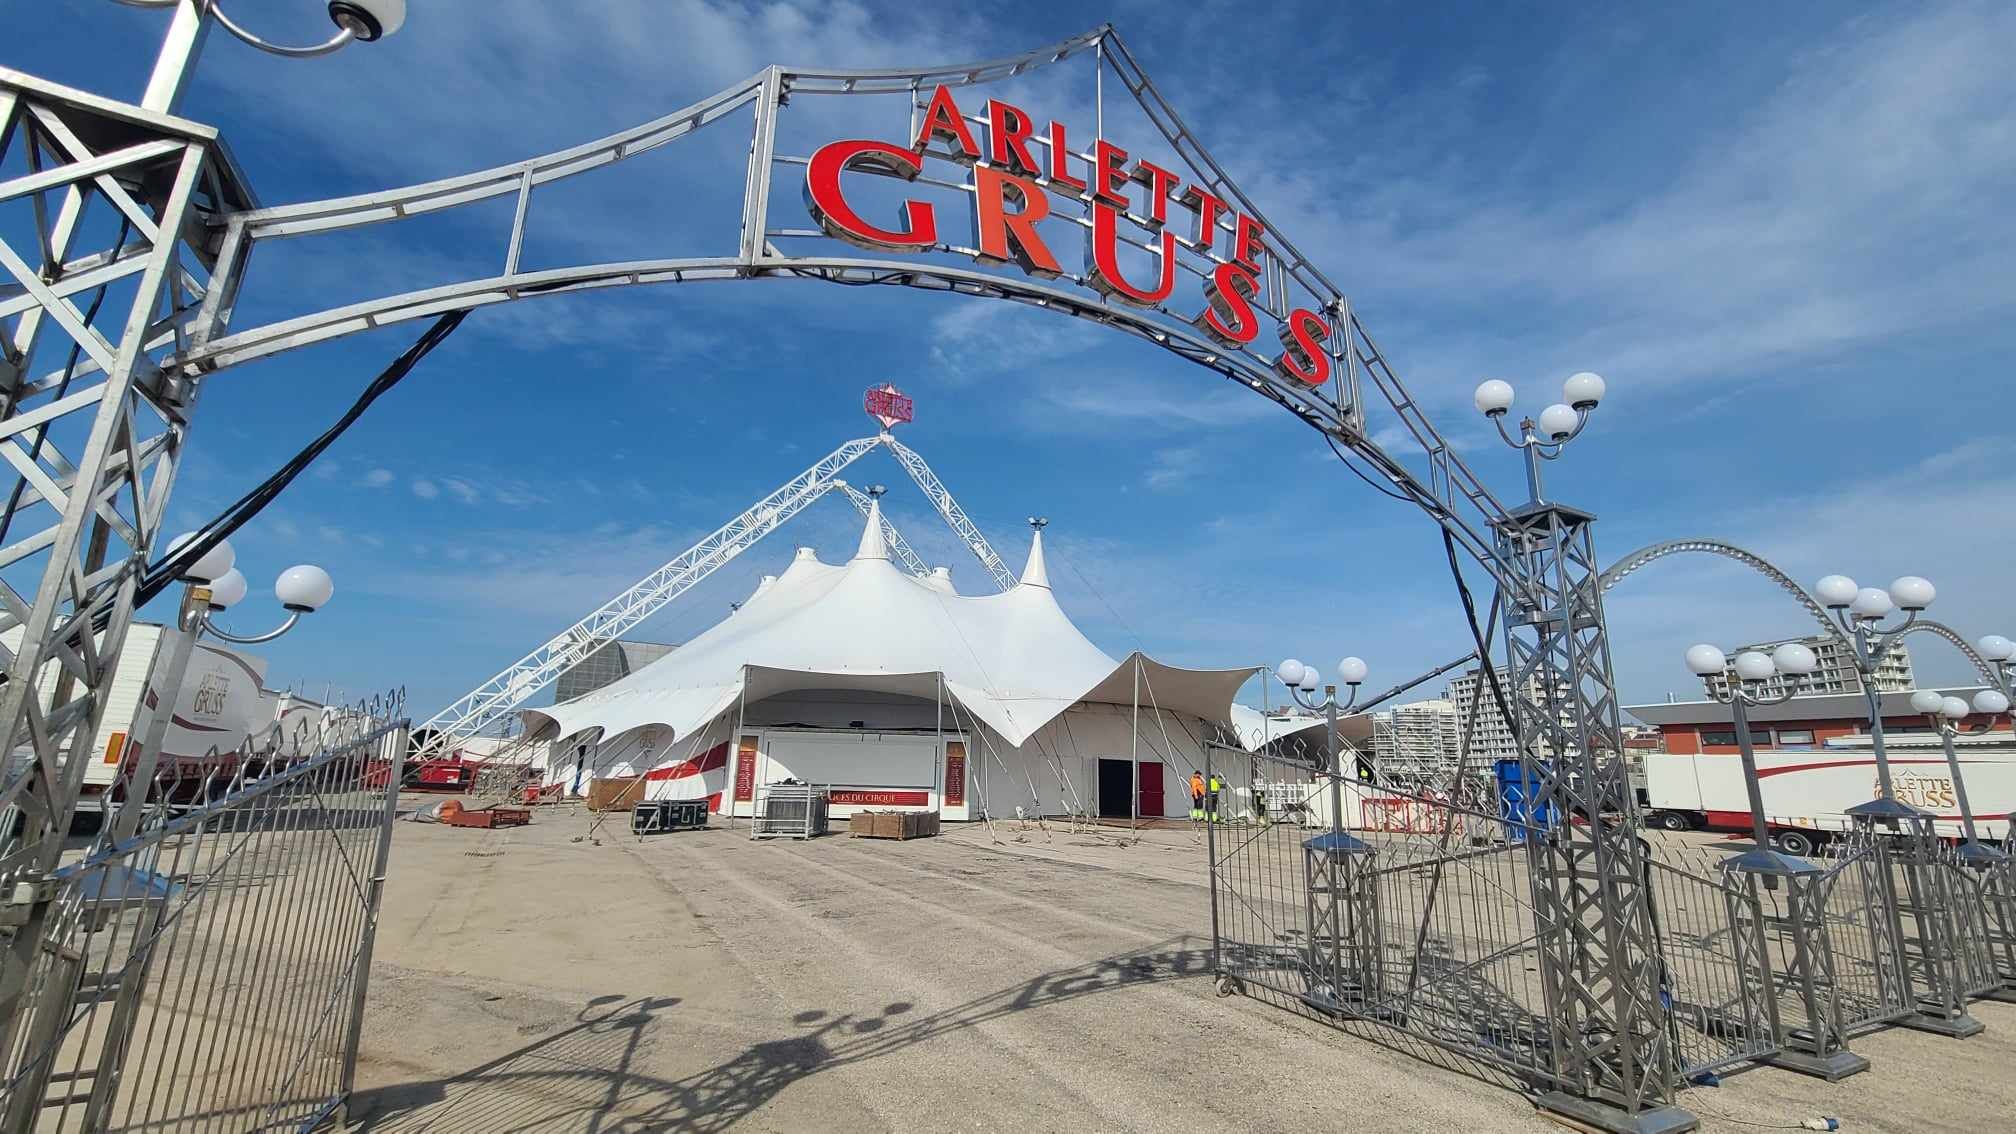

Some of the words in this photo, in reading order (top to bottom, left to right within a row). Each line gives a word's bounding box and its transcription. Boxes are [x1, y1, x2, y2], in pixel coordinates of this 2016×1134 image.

[803, 139, 1331, 386] GRUSS
[915, 83, 1265, 275] ARLETTE
[851, 793, 864, 802] DU
